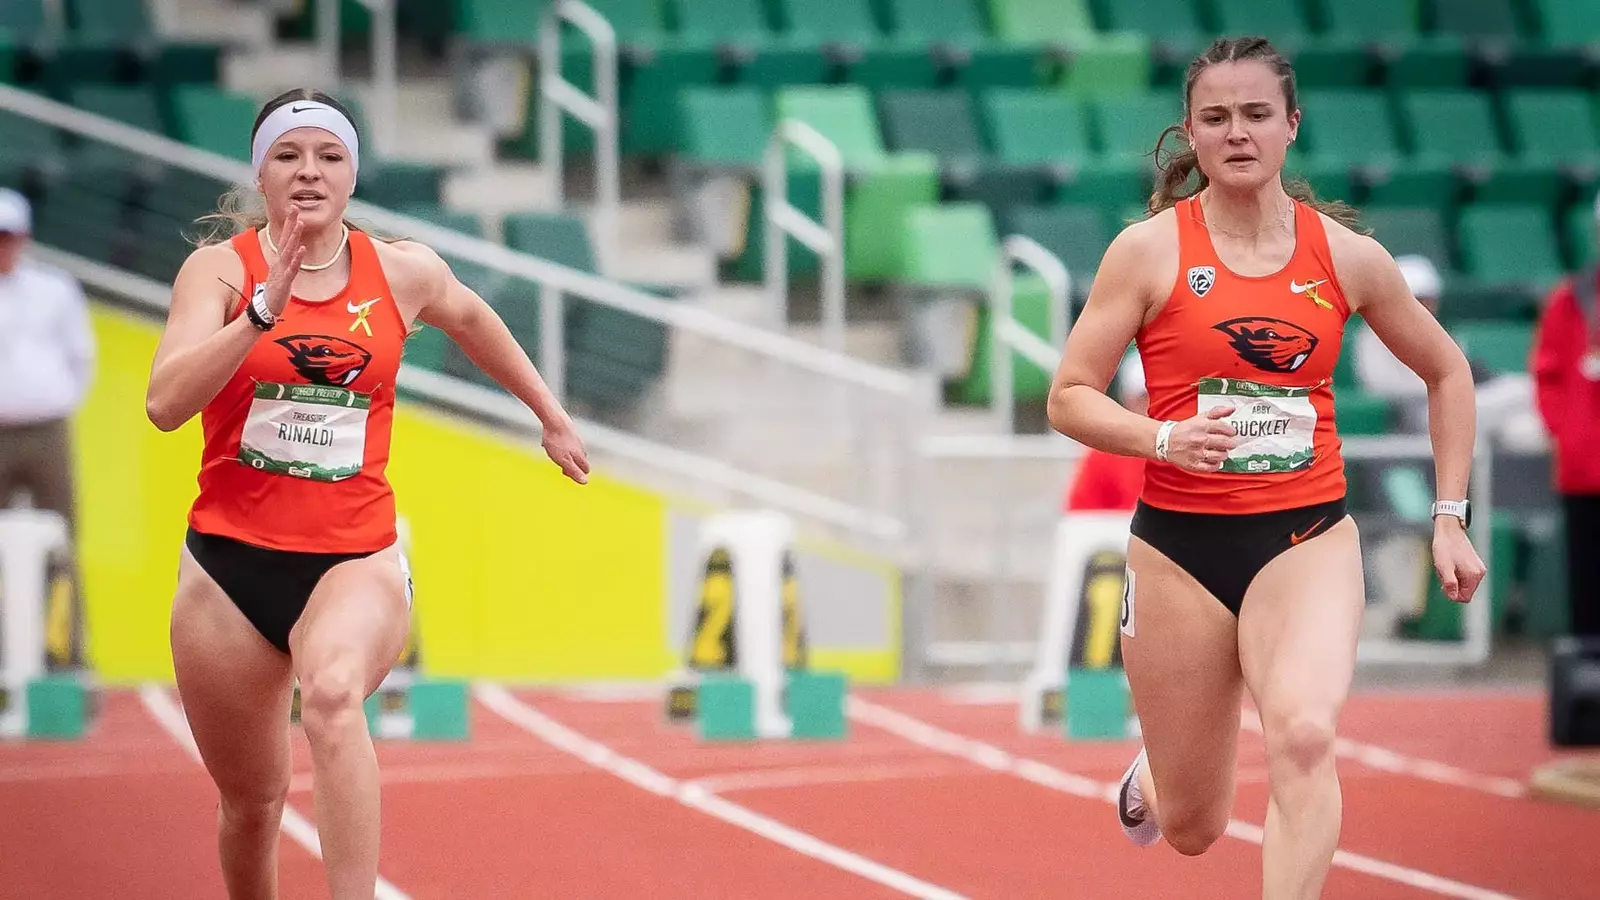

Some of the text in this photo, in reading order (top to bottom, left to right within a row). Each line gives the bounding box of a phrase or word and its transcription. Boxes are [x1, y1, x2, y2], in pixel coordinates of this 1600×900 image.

[1195, 279, 1208, 291] 12
[1252, 405, 1271, 415] ABBY
[293, 412, 327, 423] TREASURE
[278, 423, 334, 447] RINALDI
